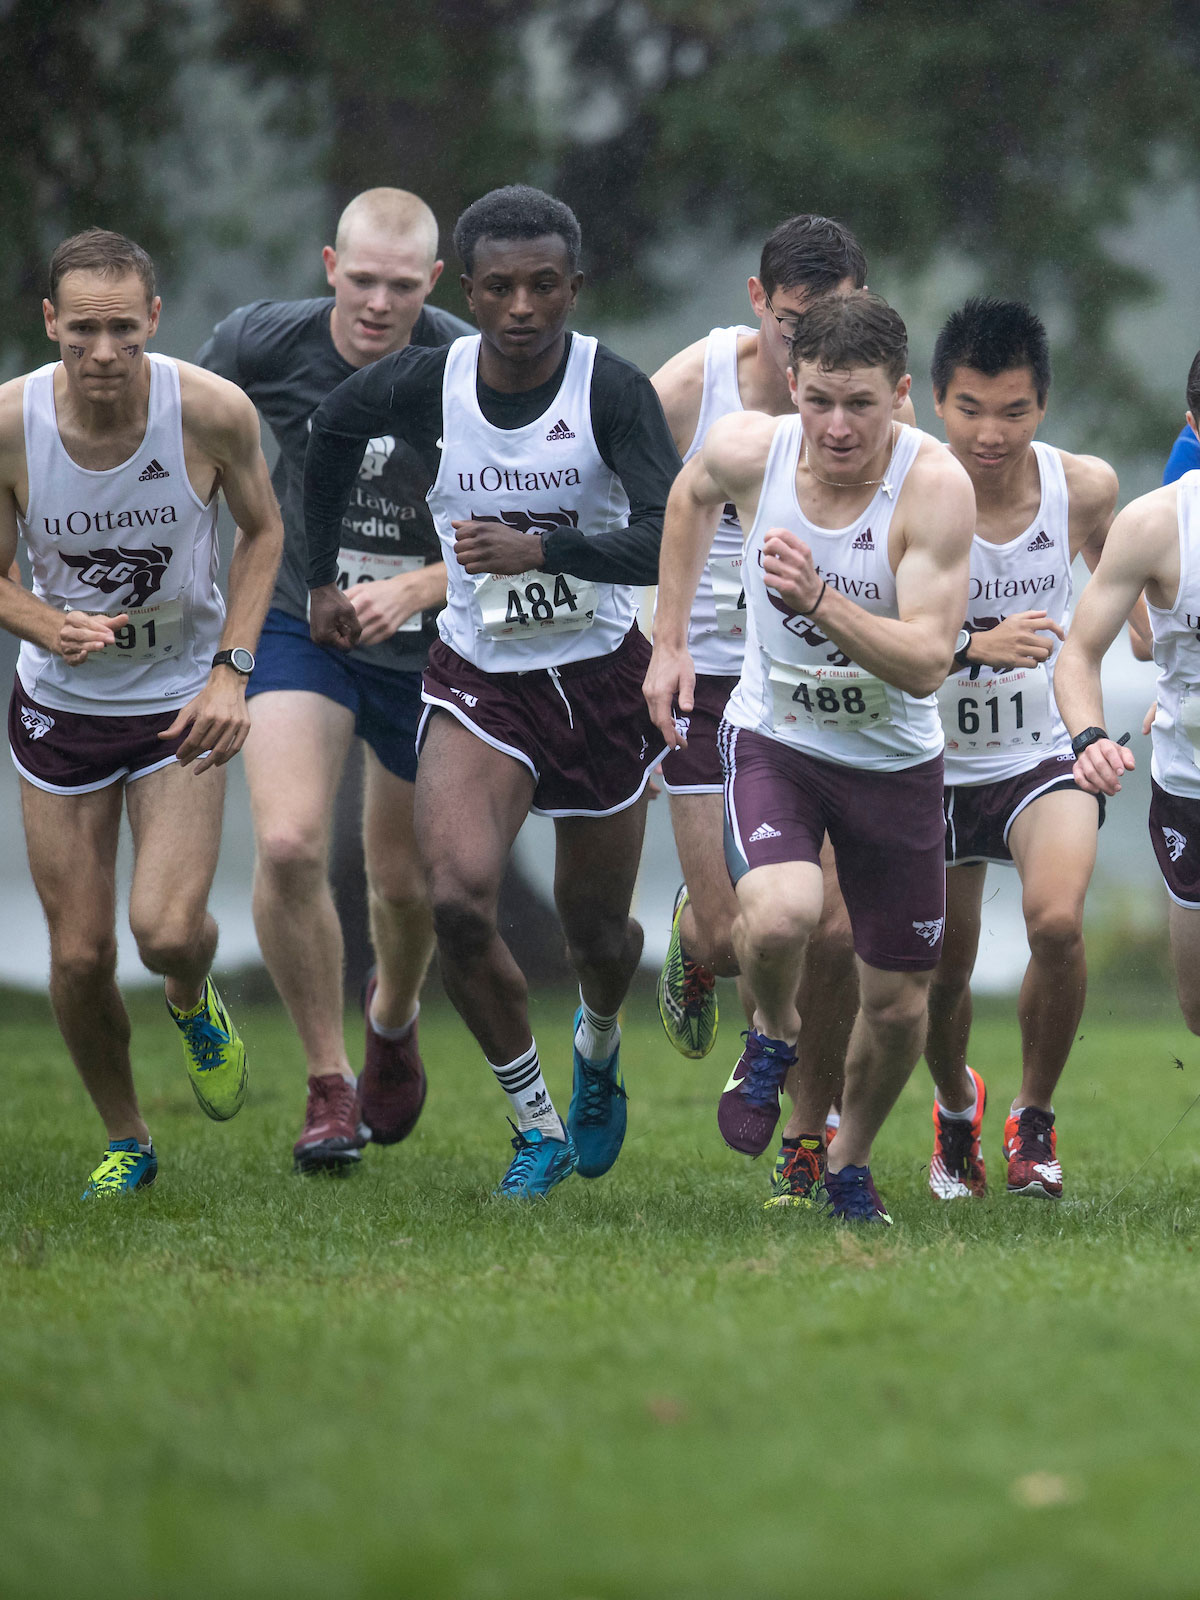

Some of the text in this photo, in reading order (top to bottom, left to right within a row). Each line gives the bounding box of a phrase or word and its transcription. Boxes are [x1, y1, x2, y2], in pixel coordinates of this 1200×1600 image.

[546, 431, 576, 441] adidas
[138, 470, 170, 482] adidas
[1027, 540, 1055, 552] adidas
[505, 574, 578, 627] 484
[104, 619, 156, 650] 91
[829, 670, 860, 678] CHALLENGE
[792, 682, 866, 714] 488
[958, 691, 1024, 734] 611
[749, 830, 782, 842] adidas
